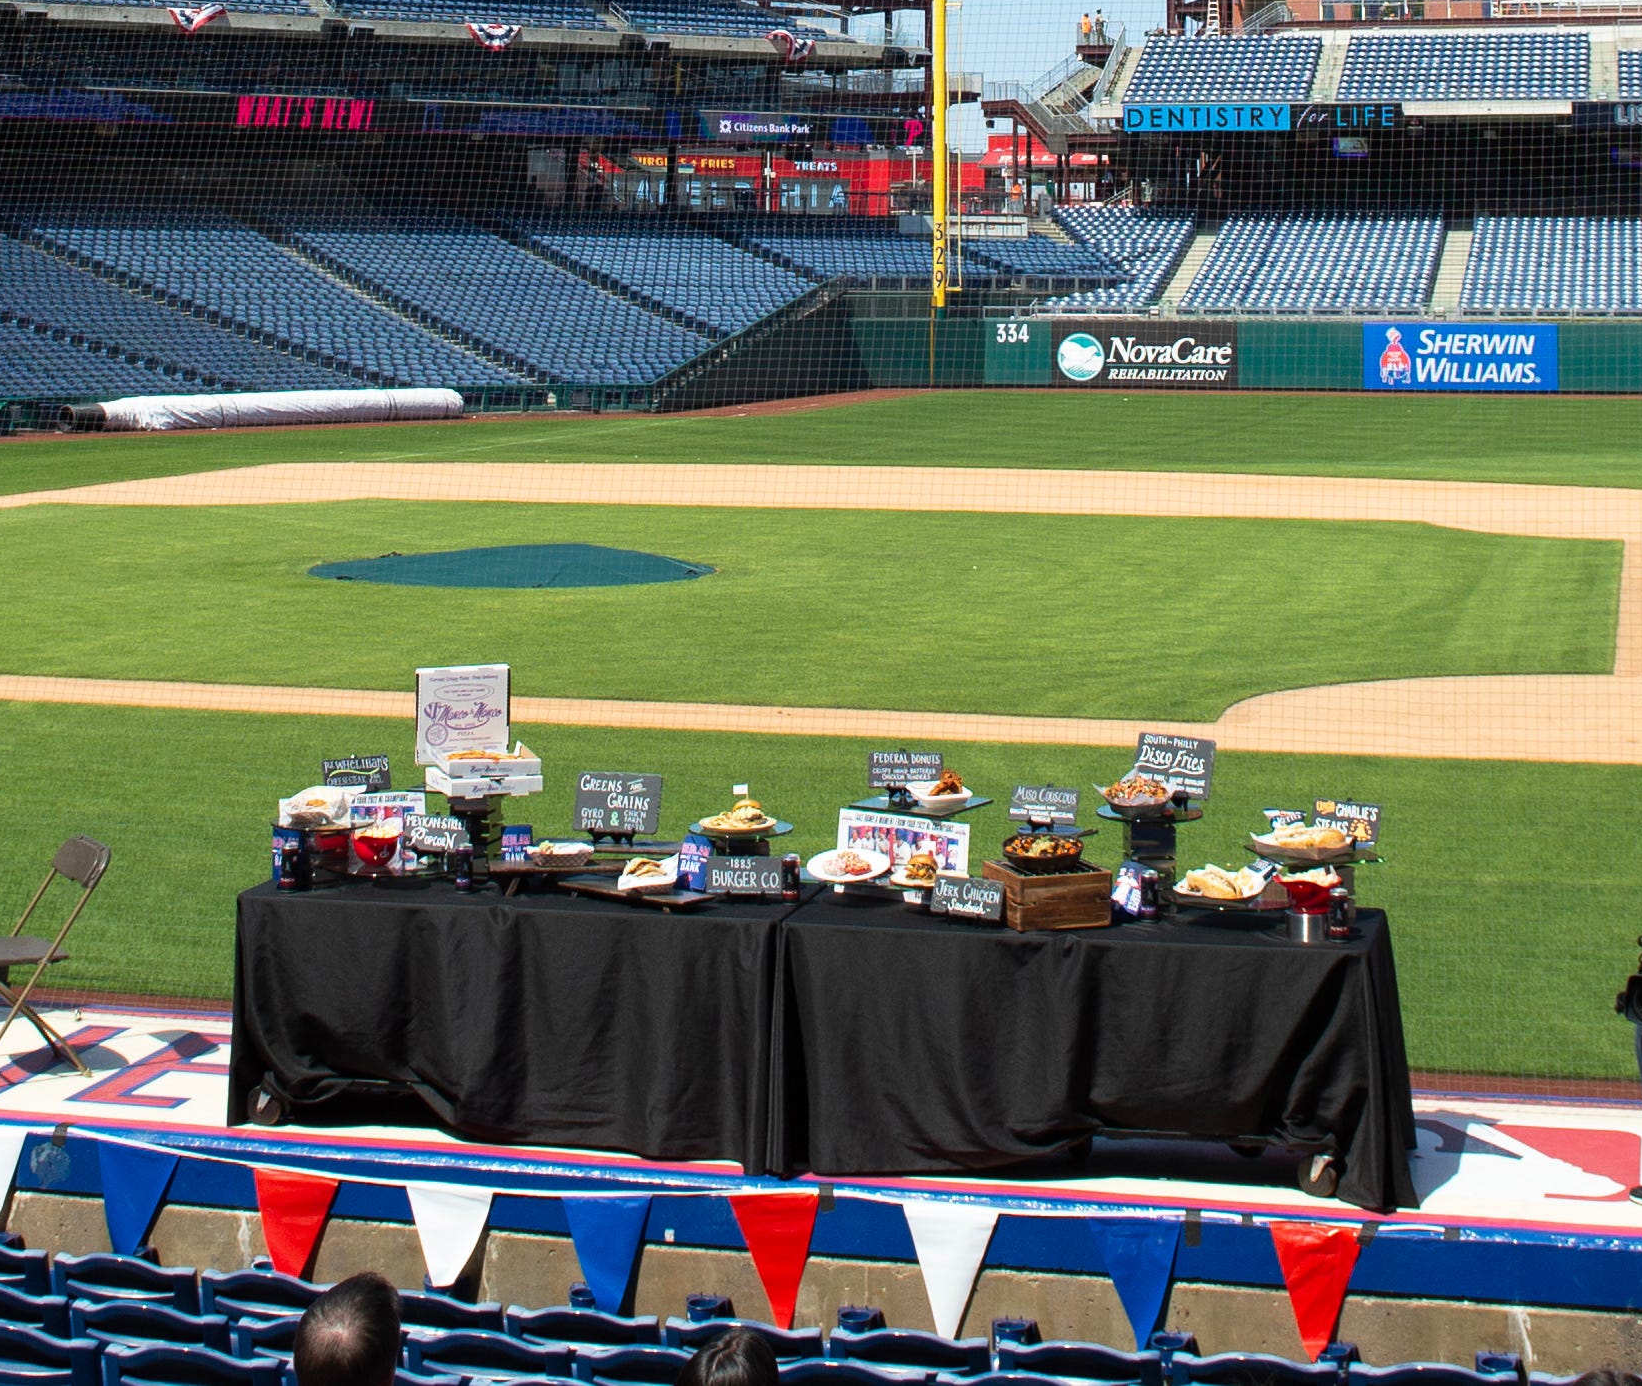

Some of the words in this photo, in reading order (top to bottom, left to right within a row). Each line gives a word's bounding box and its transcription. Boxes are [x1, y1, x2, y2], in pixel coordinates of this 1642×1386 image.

[236, 94, 314, 128] WHAT'S
[1126, 105, 1285, 127] DENTISTRY
[1296, 103, 1328, 127] for
[1336, 105, 1395, 127] LIFE
[734, 121, 768, 134] Citizens
[769, 122, 790, 134] Bank
[791, 122, 811, 135] Park
[700, 157, 735, 169] FRIES
[794, 160, 838, 172] TREATS
[996, 323, 1030, 343] 334
[1417, 329, 1535, 355] SHERWIN
[1106, 337, 1232, 364] NovaCare
[1107, 368, 1227, 381] REHABILITATION
[1415, 357, 1537, 383] WILLIAMS
[873, 753, 909, 764] FEDERAL
[911, 753, 940, 764] DONUTS
[1138, 744, 1173, 765] Disco
[1172, 750, 1206, 771] Fries
[581, 774, 623, 792] GREENS
[607, 792, 650, 811] GRAINS
[406, 814, 441, 829] MEXICAN
[581, 807, 604, 819] GYRO
[610, 811, 619, 826] &
[1335, 803, 1378, 822] CHARLIE'S
[581, 818, 604, 829] PITA
[1314, 817, 1348, 835] STEAKS
[505, 851, 525, 862] BANK
[679, 859, 701, 873] BANK
[712, 870, 757, 888] BURGER
[761, 872, 781, 889] CO.
[935, 878, 959, 898] JERK
[963, 883, 1000, 904] CHICKEN
